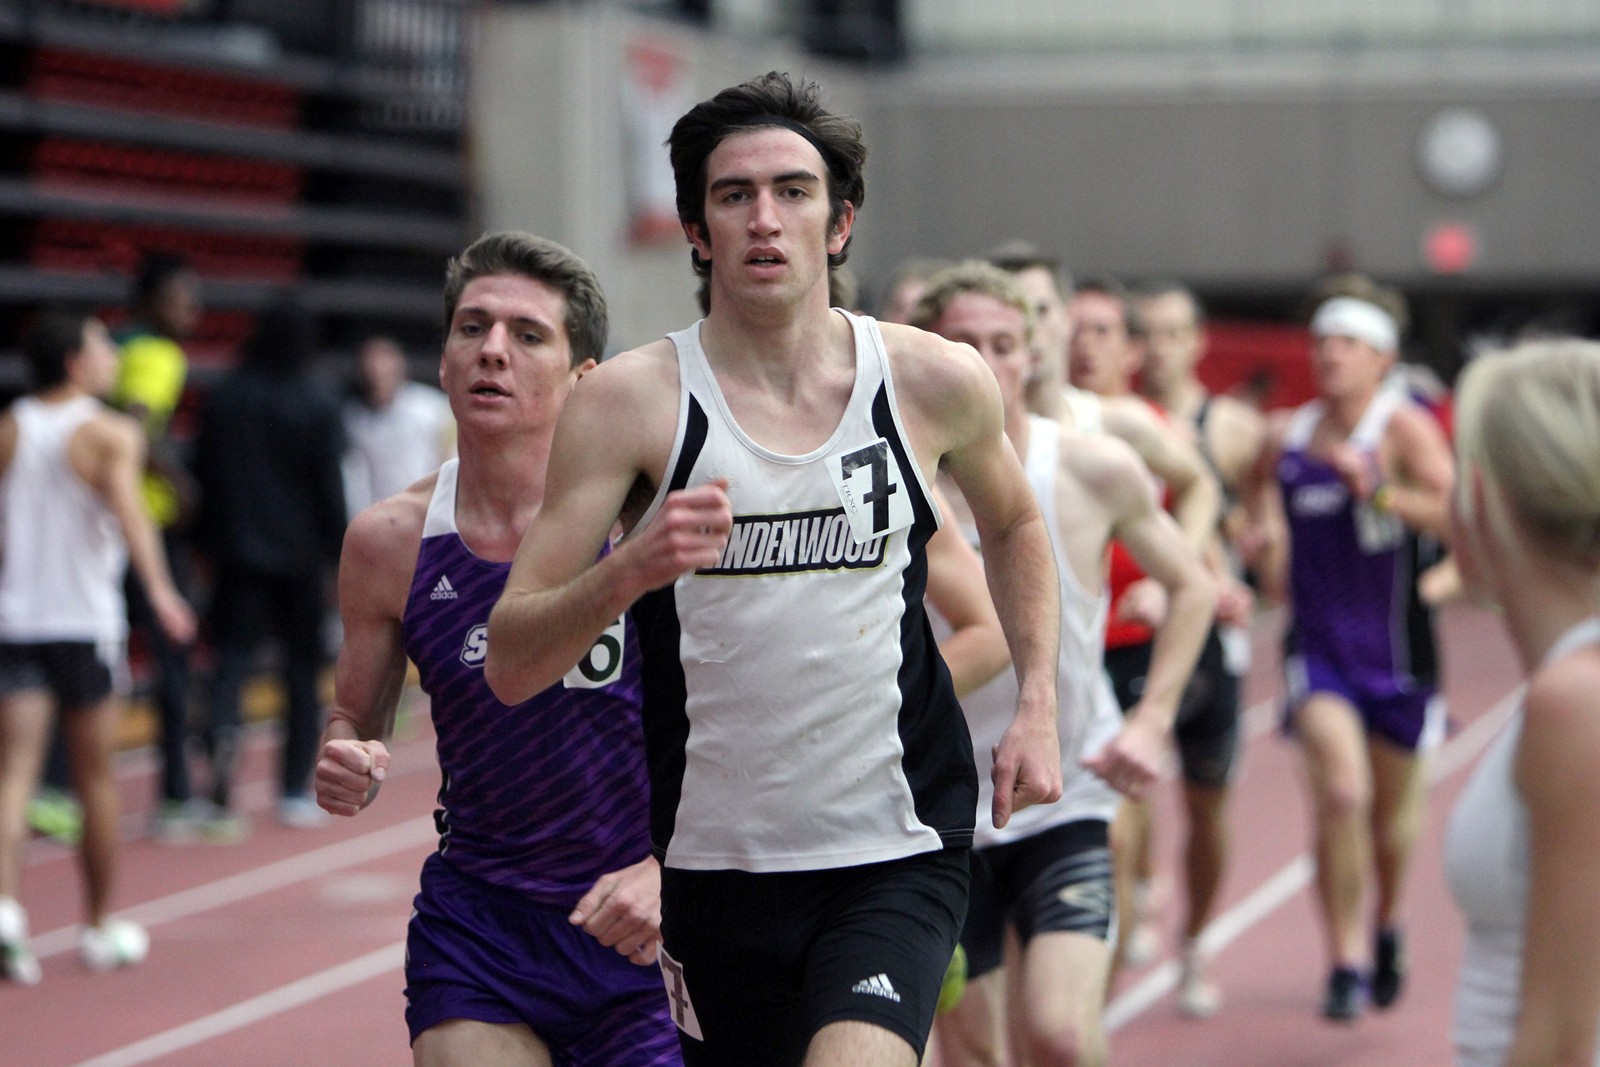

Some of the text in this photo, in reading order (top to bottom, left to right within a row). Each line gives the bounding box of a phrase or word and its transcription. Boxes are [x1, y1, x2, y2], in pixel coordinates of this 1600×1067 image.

[841, 440, 897, 534] 7
[701, 513, 884, 569] NDENWOO
[430, 590, 458, 600] adidas
[660, 950, 689, 1028] 7
